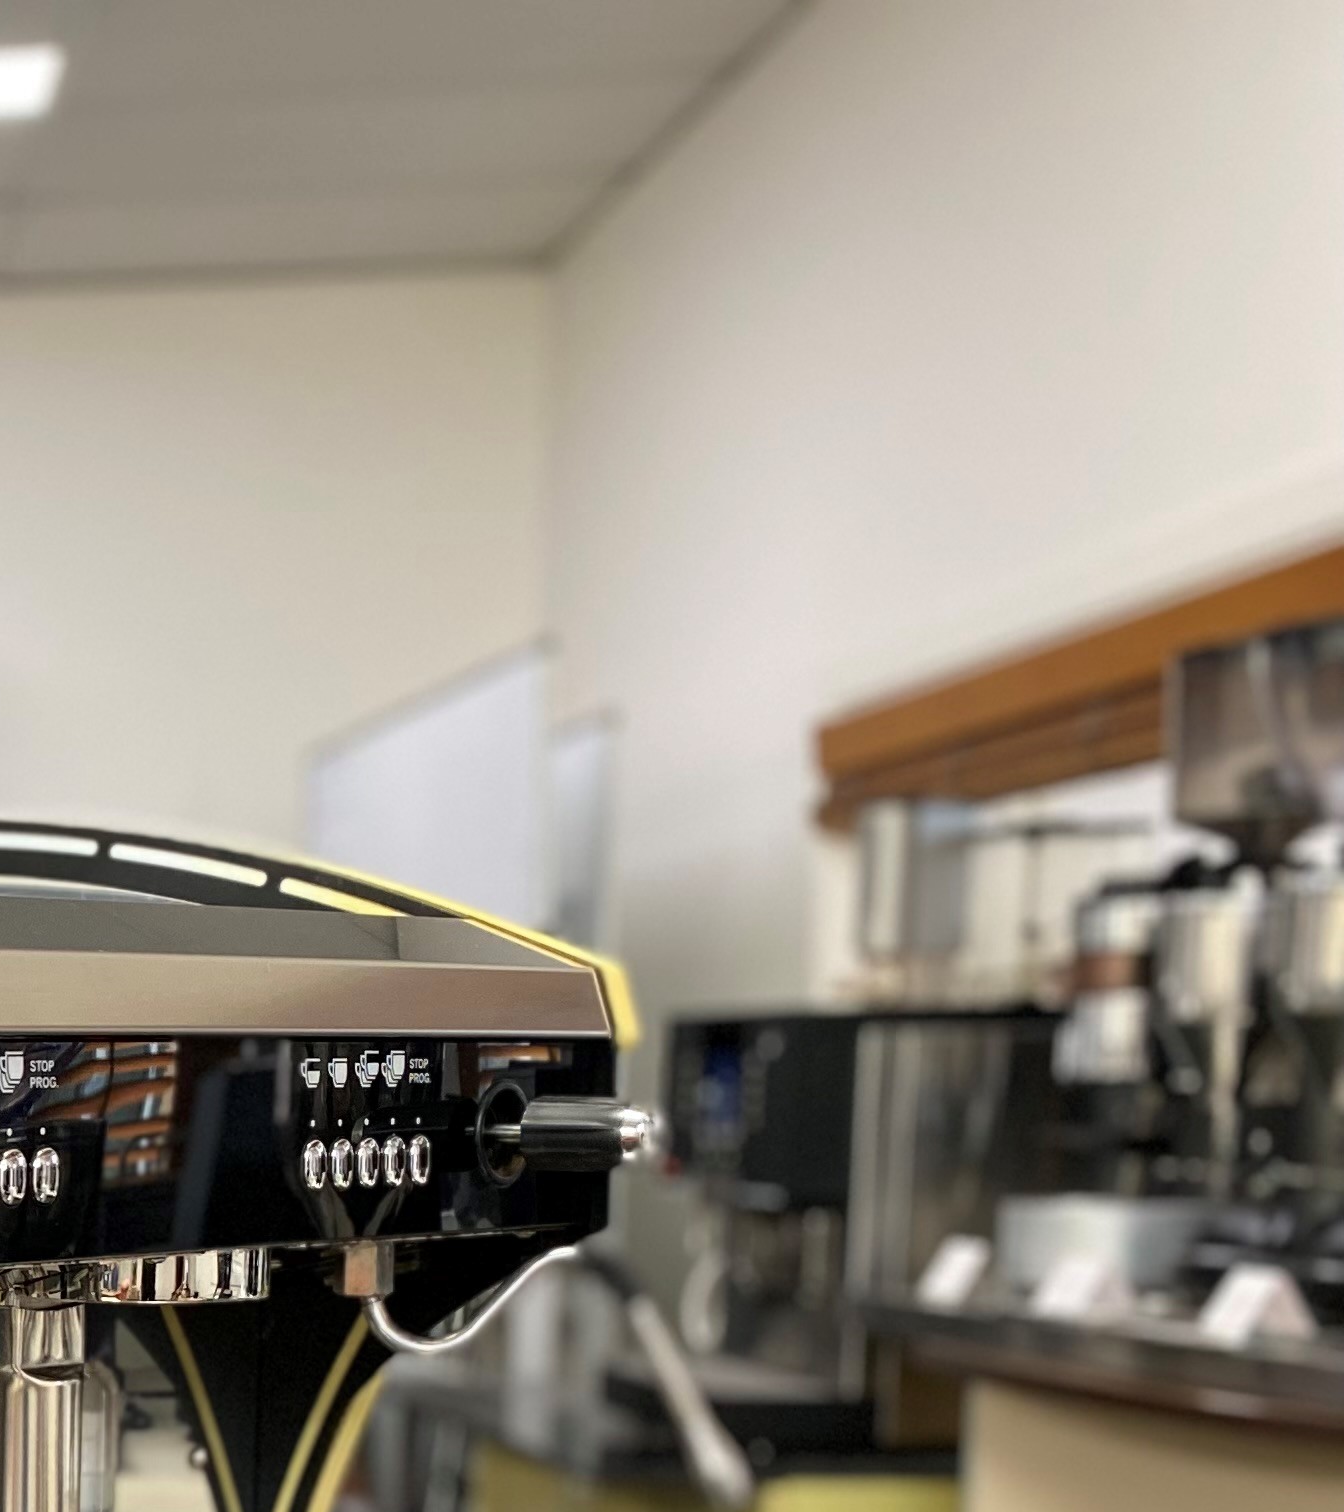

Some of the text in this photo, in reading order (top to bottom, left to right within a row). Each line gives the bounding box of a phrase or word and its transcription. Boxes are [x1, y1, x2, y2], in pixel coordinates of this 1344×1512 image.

[29, 1060, 55, 1072] STOP
[409, 1058, 429, 1069] STOP
[29, 1076, 59, 1089] PROG.
[408, 1072, 432, 1084] PROG.
